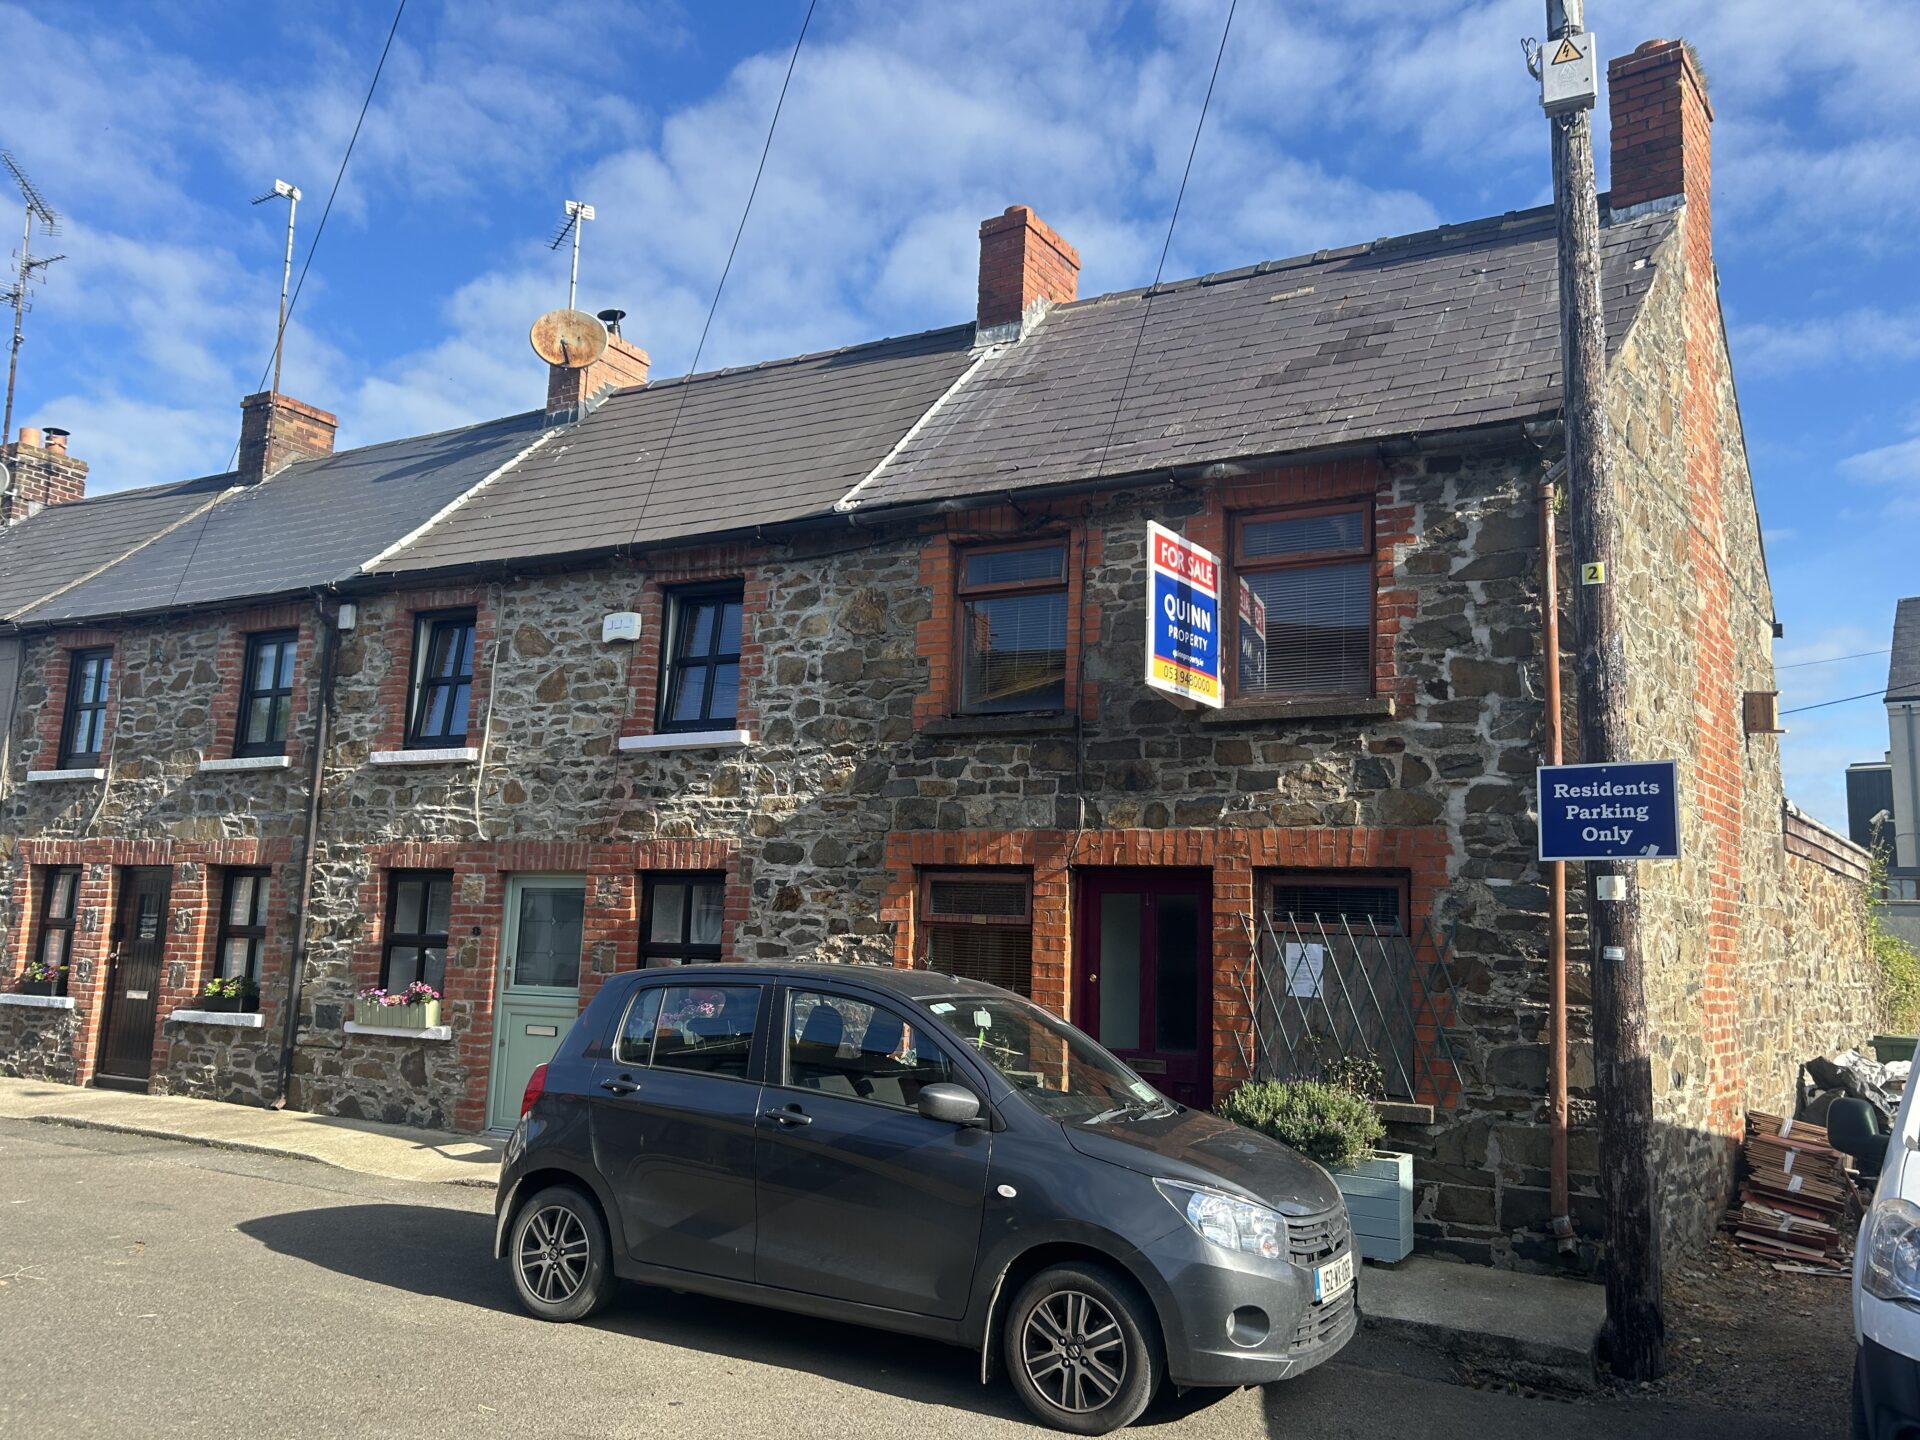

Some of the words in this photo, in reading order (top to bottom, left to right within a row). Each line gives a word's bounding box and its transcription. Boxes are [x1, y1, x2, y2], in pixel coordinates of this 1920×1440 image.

[1161, 541, 1185, 573] FOR
[1187, 556, 1214, 586] SALE
[1587, 565, 1599, 580] 2
[1163, 593, 1211, 634] QUINN
[1168, 623, 1208, 652] PROPERTY
[1163, 665, 1178, 681] 053
[1553, 781, 1660, 798] Residents
[1565, 803, 1650, 822] Parking
[1582, 826, 1634, 845] Only
